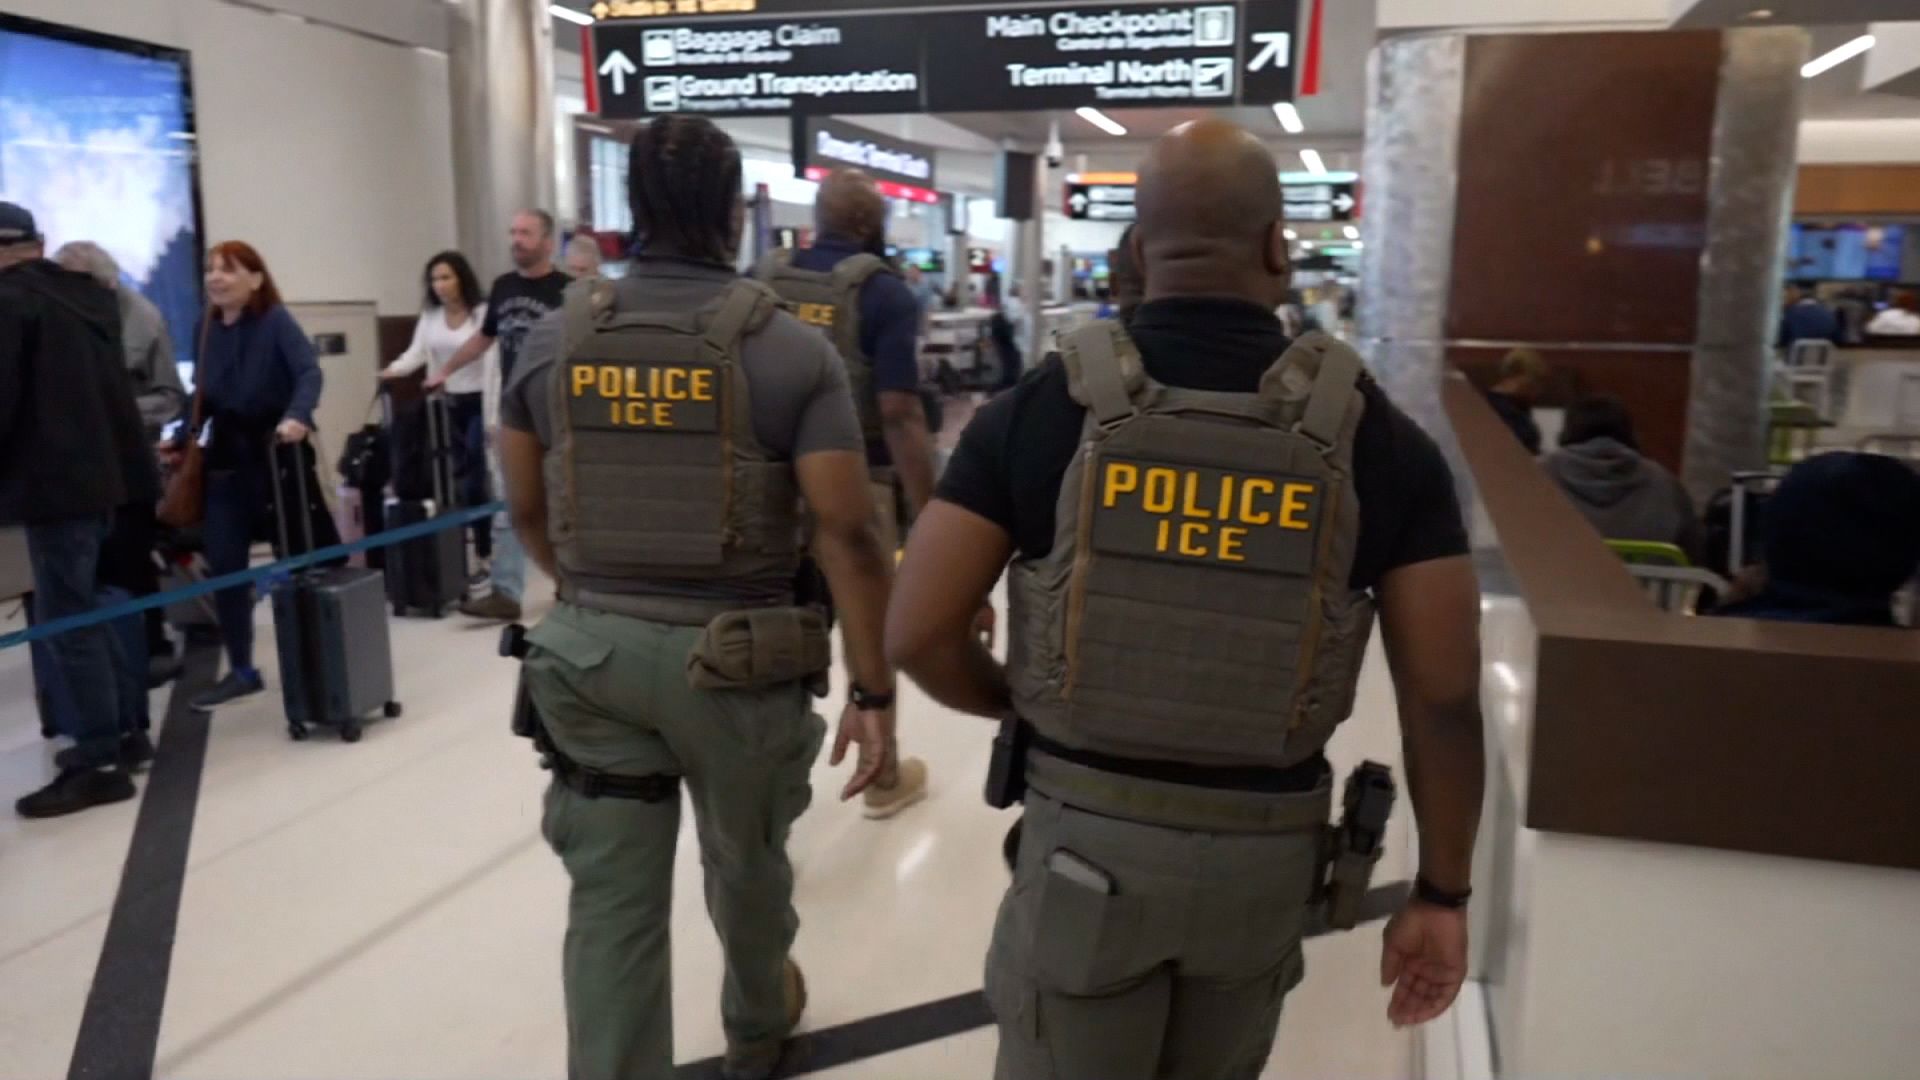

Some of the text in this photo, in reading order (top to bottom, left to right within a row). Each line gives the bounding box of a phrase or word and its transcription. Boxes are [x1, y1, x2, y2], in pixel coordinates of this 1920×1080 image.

[987, 9, 1193, 37] Main Checkpoint
[676, 24, 841, 52] Baggage Claim
[680, 69, 917, 97] Ground Transportation
[1007, 59, 1193, 86] Terminal North
[572, 365, 713, 401] POLICE
[611, 401, 673, 426] ICE
[1103, 463, 1314, 529] POLICE
[1156, 519, 1248, 561] ICE
